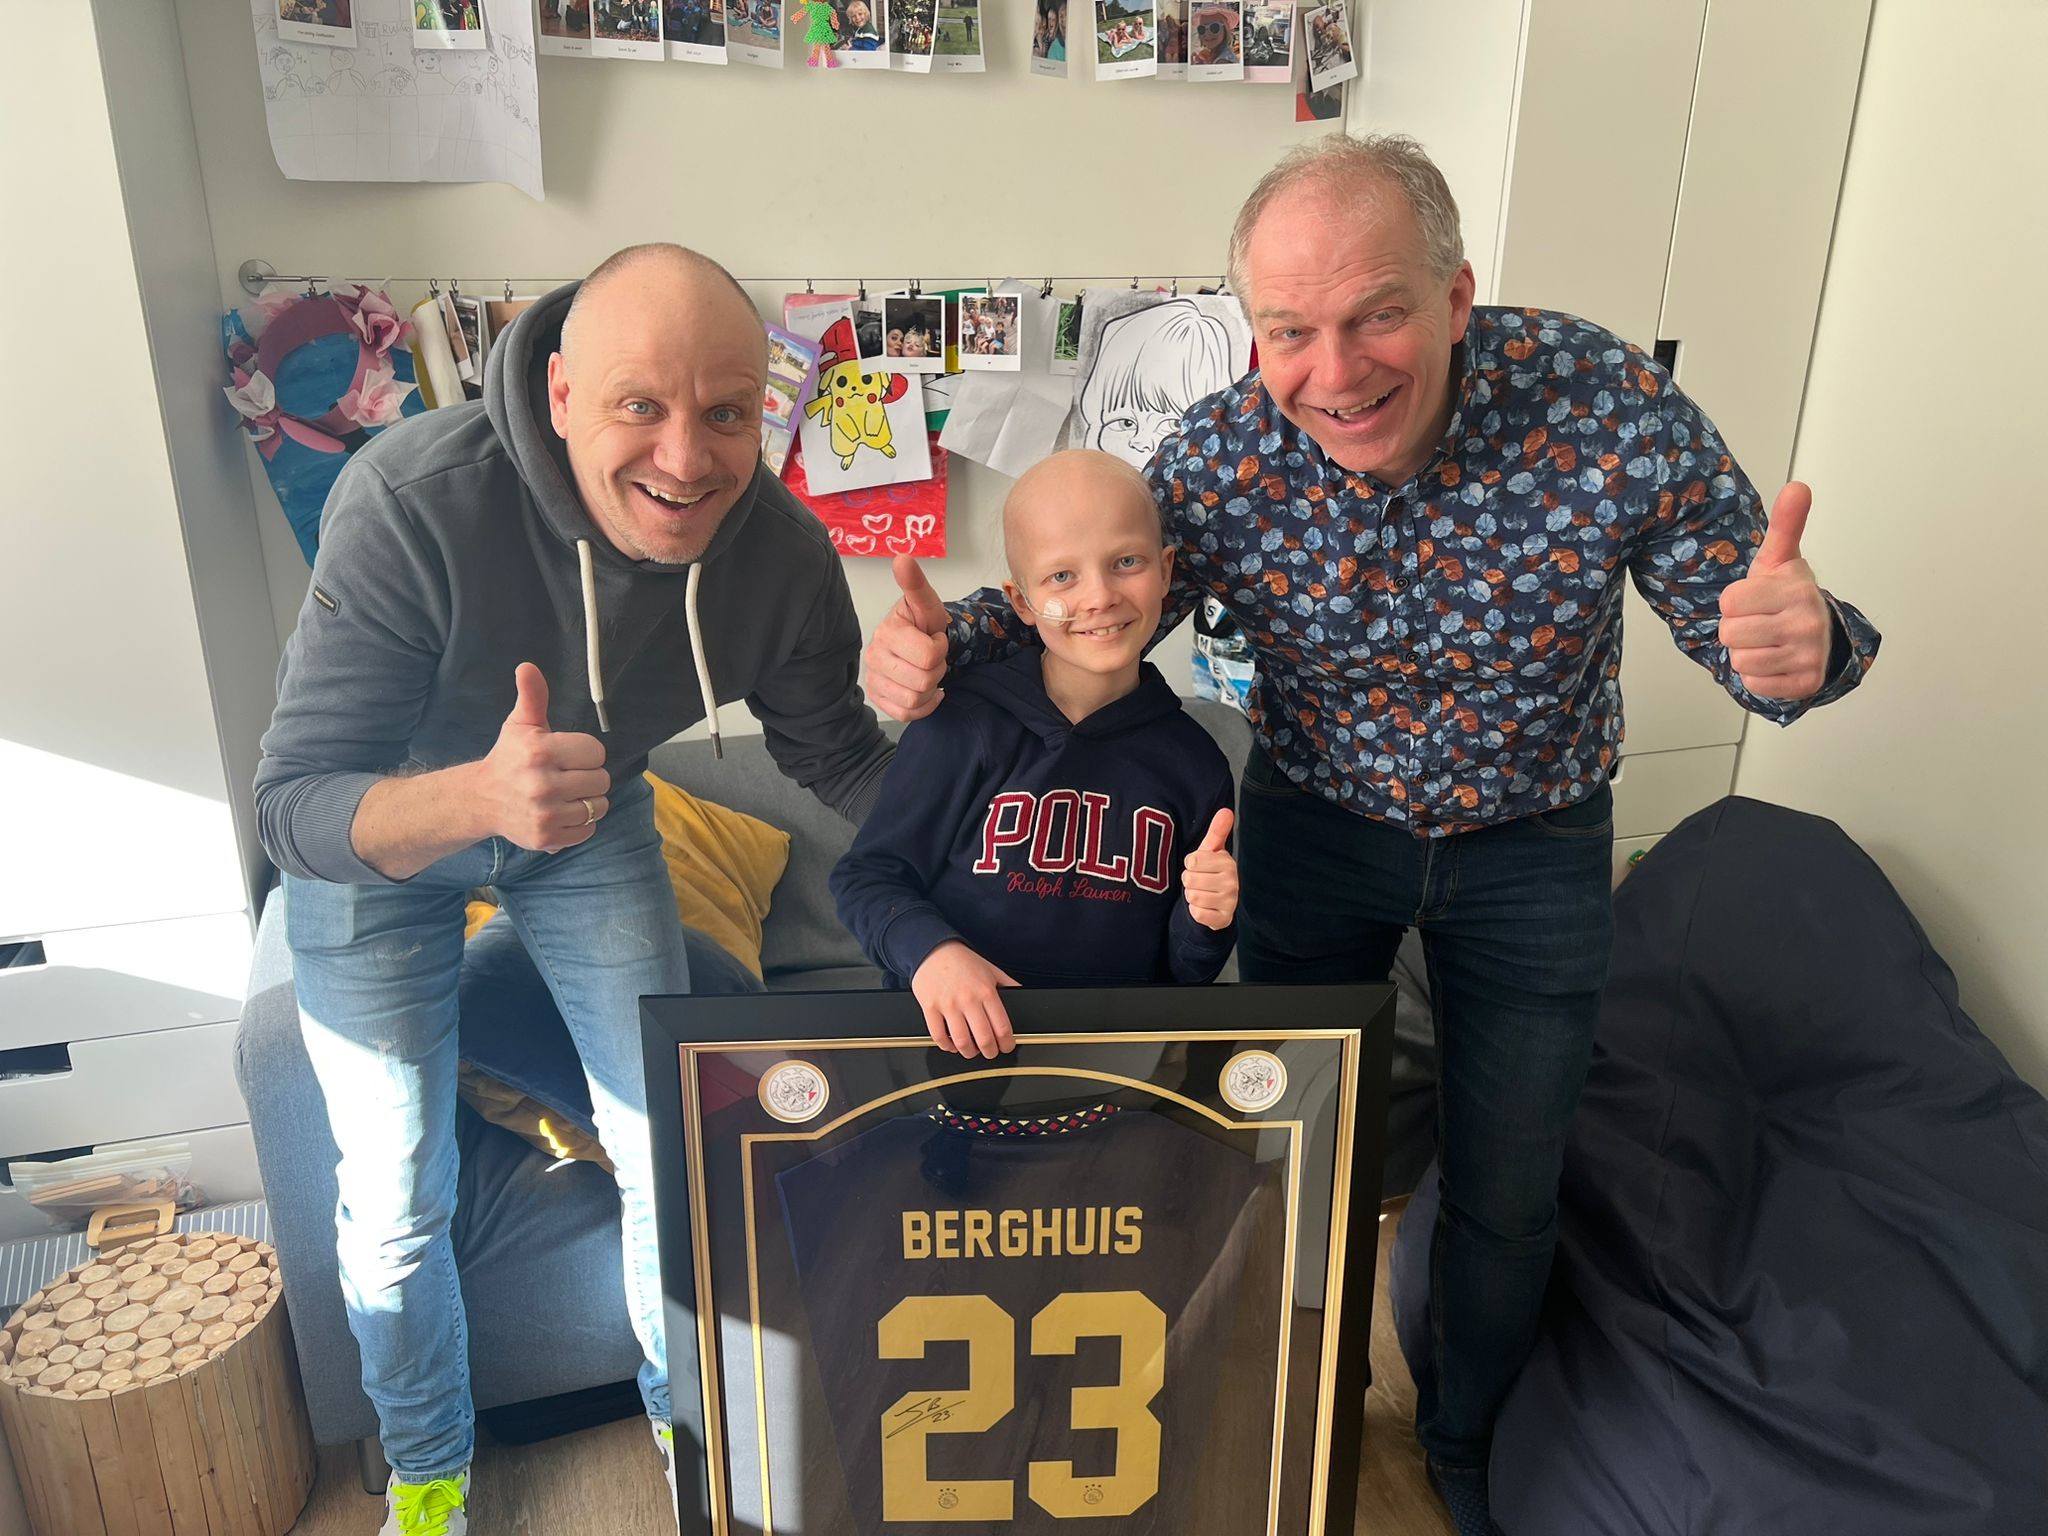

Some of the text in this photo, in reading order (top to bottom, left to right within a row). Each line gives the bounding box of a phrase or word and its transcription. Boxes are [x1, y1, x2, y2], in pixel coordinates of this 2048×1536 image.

[973, 788, 1175, 894] POLO
[1007, 871, 1132, 903] Ralph Lauren
[902, 1206, 1143, 1260] BERGHUIS
[877, 1290, 1167, 1522] 23
